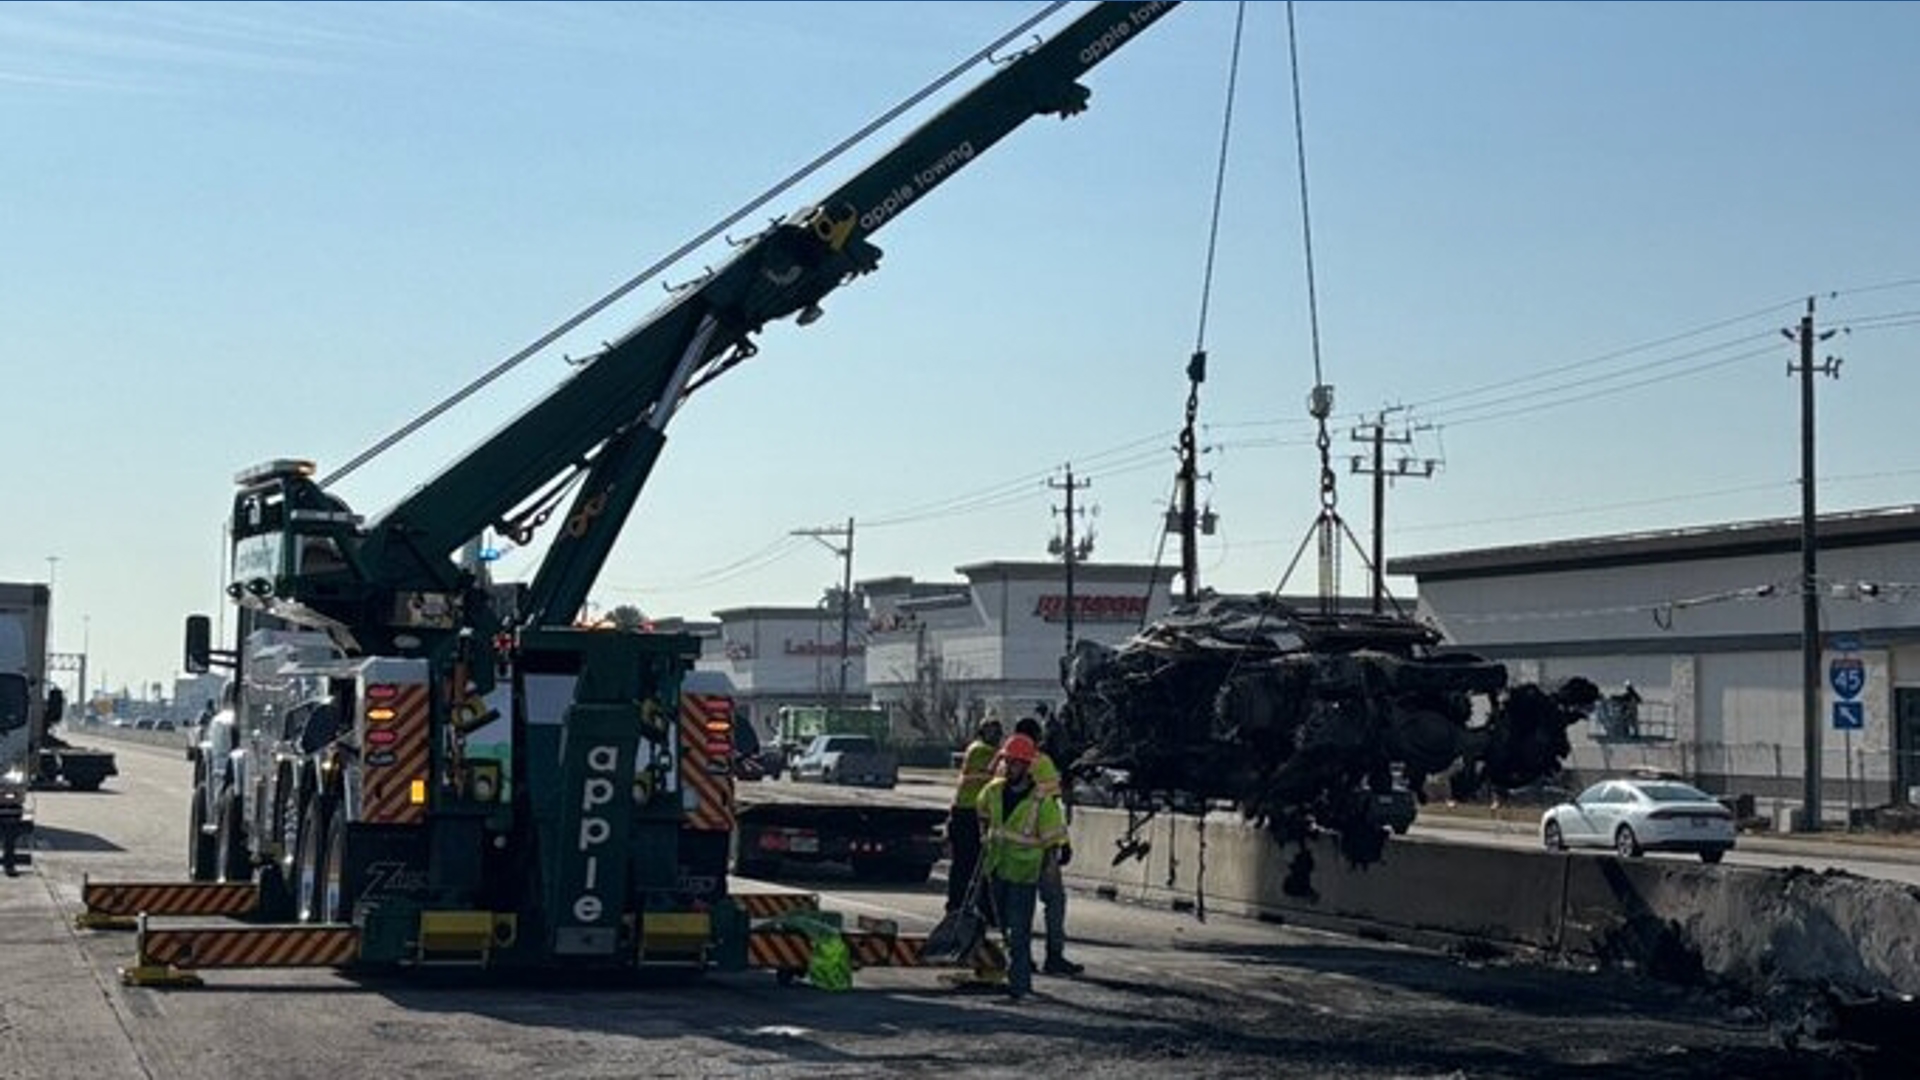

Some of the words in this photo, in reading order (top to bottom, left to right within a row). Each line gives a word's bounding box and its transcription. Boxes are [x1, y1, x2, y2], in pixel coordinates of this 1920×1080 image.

[1080, 22, 1130, 63] apple
[860, 185, 914, 230] apple
[914, 140, 975, 189] towing
[1833, 669, 1861, 692] 45
[573, 746, 619, 921] apple
